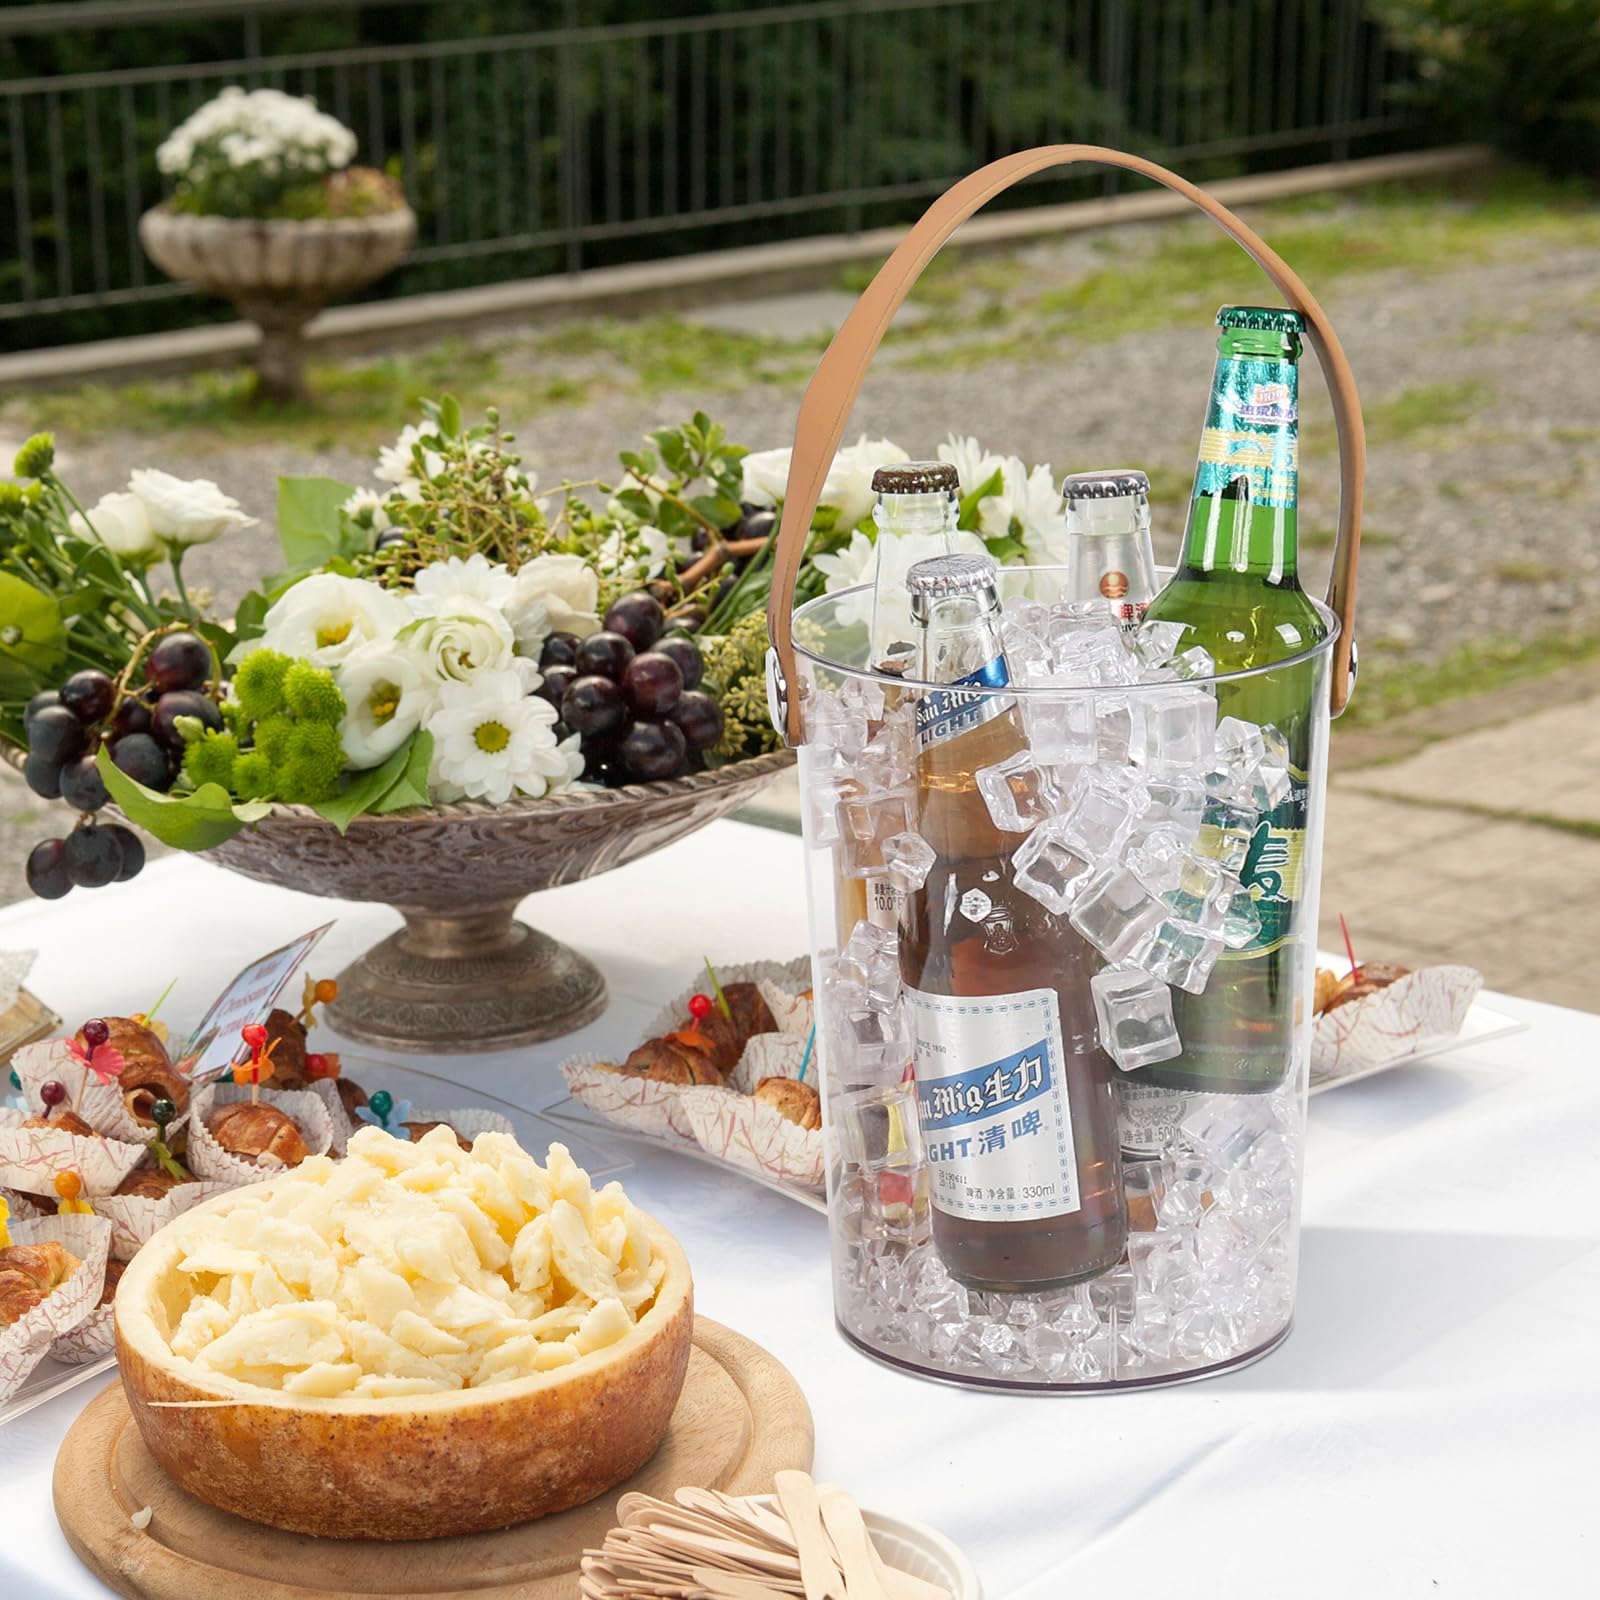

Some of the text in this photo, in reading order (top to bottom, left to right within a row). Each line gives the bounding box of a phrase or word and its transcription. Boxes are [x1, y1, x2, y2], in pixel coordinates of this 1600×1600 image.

[921, 708, 979, 745] LIGHT
[932, 1081, 985, 1120] Mig
[984, 1054, 1044, 1109] 生力
[978, 1108, 1043, 1155] 清啤
[1022, 1183, 1055, 1199] 330ml
